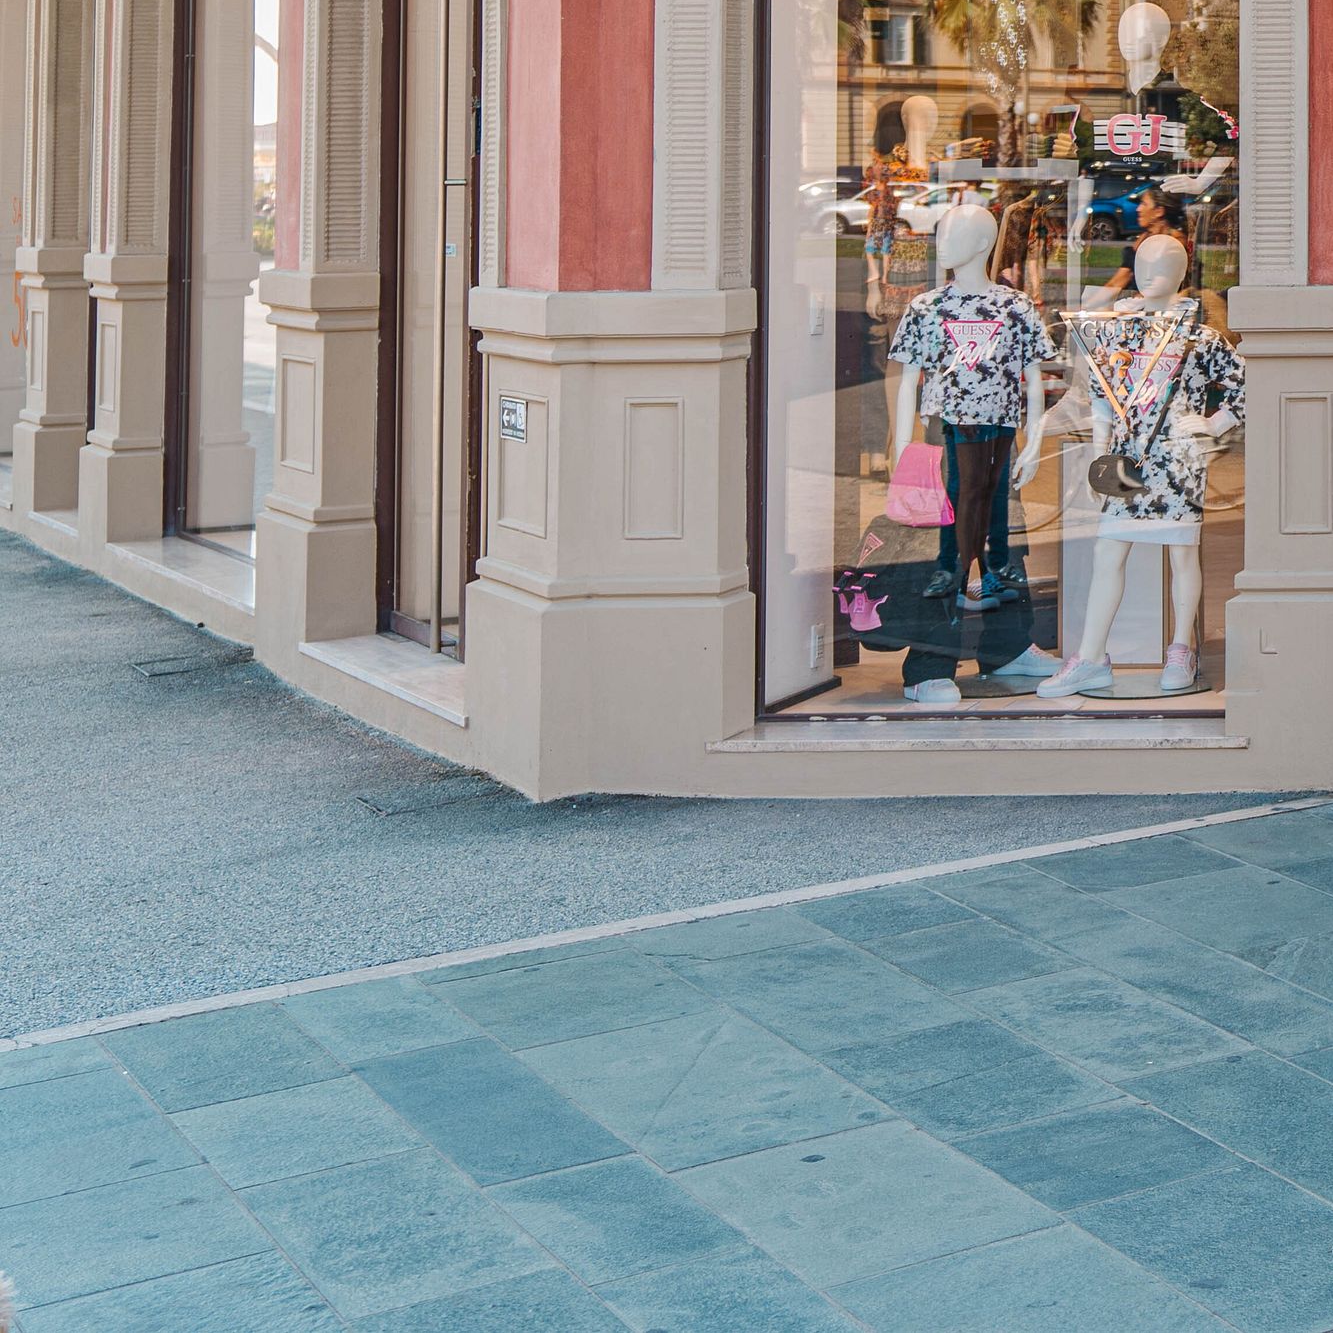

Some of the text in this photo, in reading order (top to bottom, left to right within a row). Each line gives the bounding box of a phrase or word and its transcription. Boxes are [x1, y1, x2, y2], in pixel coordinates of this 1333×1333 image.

[1107, 113, 1167, 155] GJ
[952, 325, 992, 336] GUESS
[1080, 320, 1166, 339] GUESS
